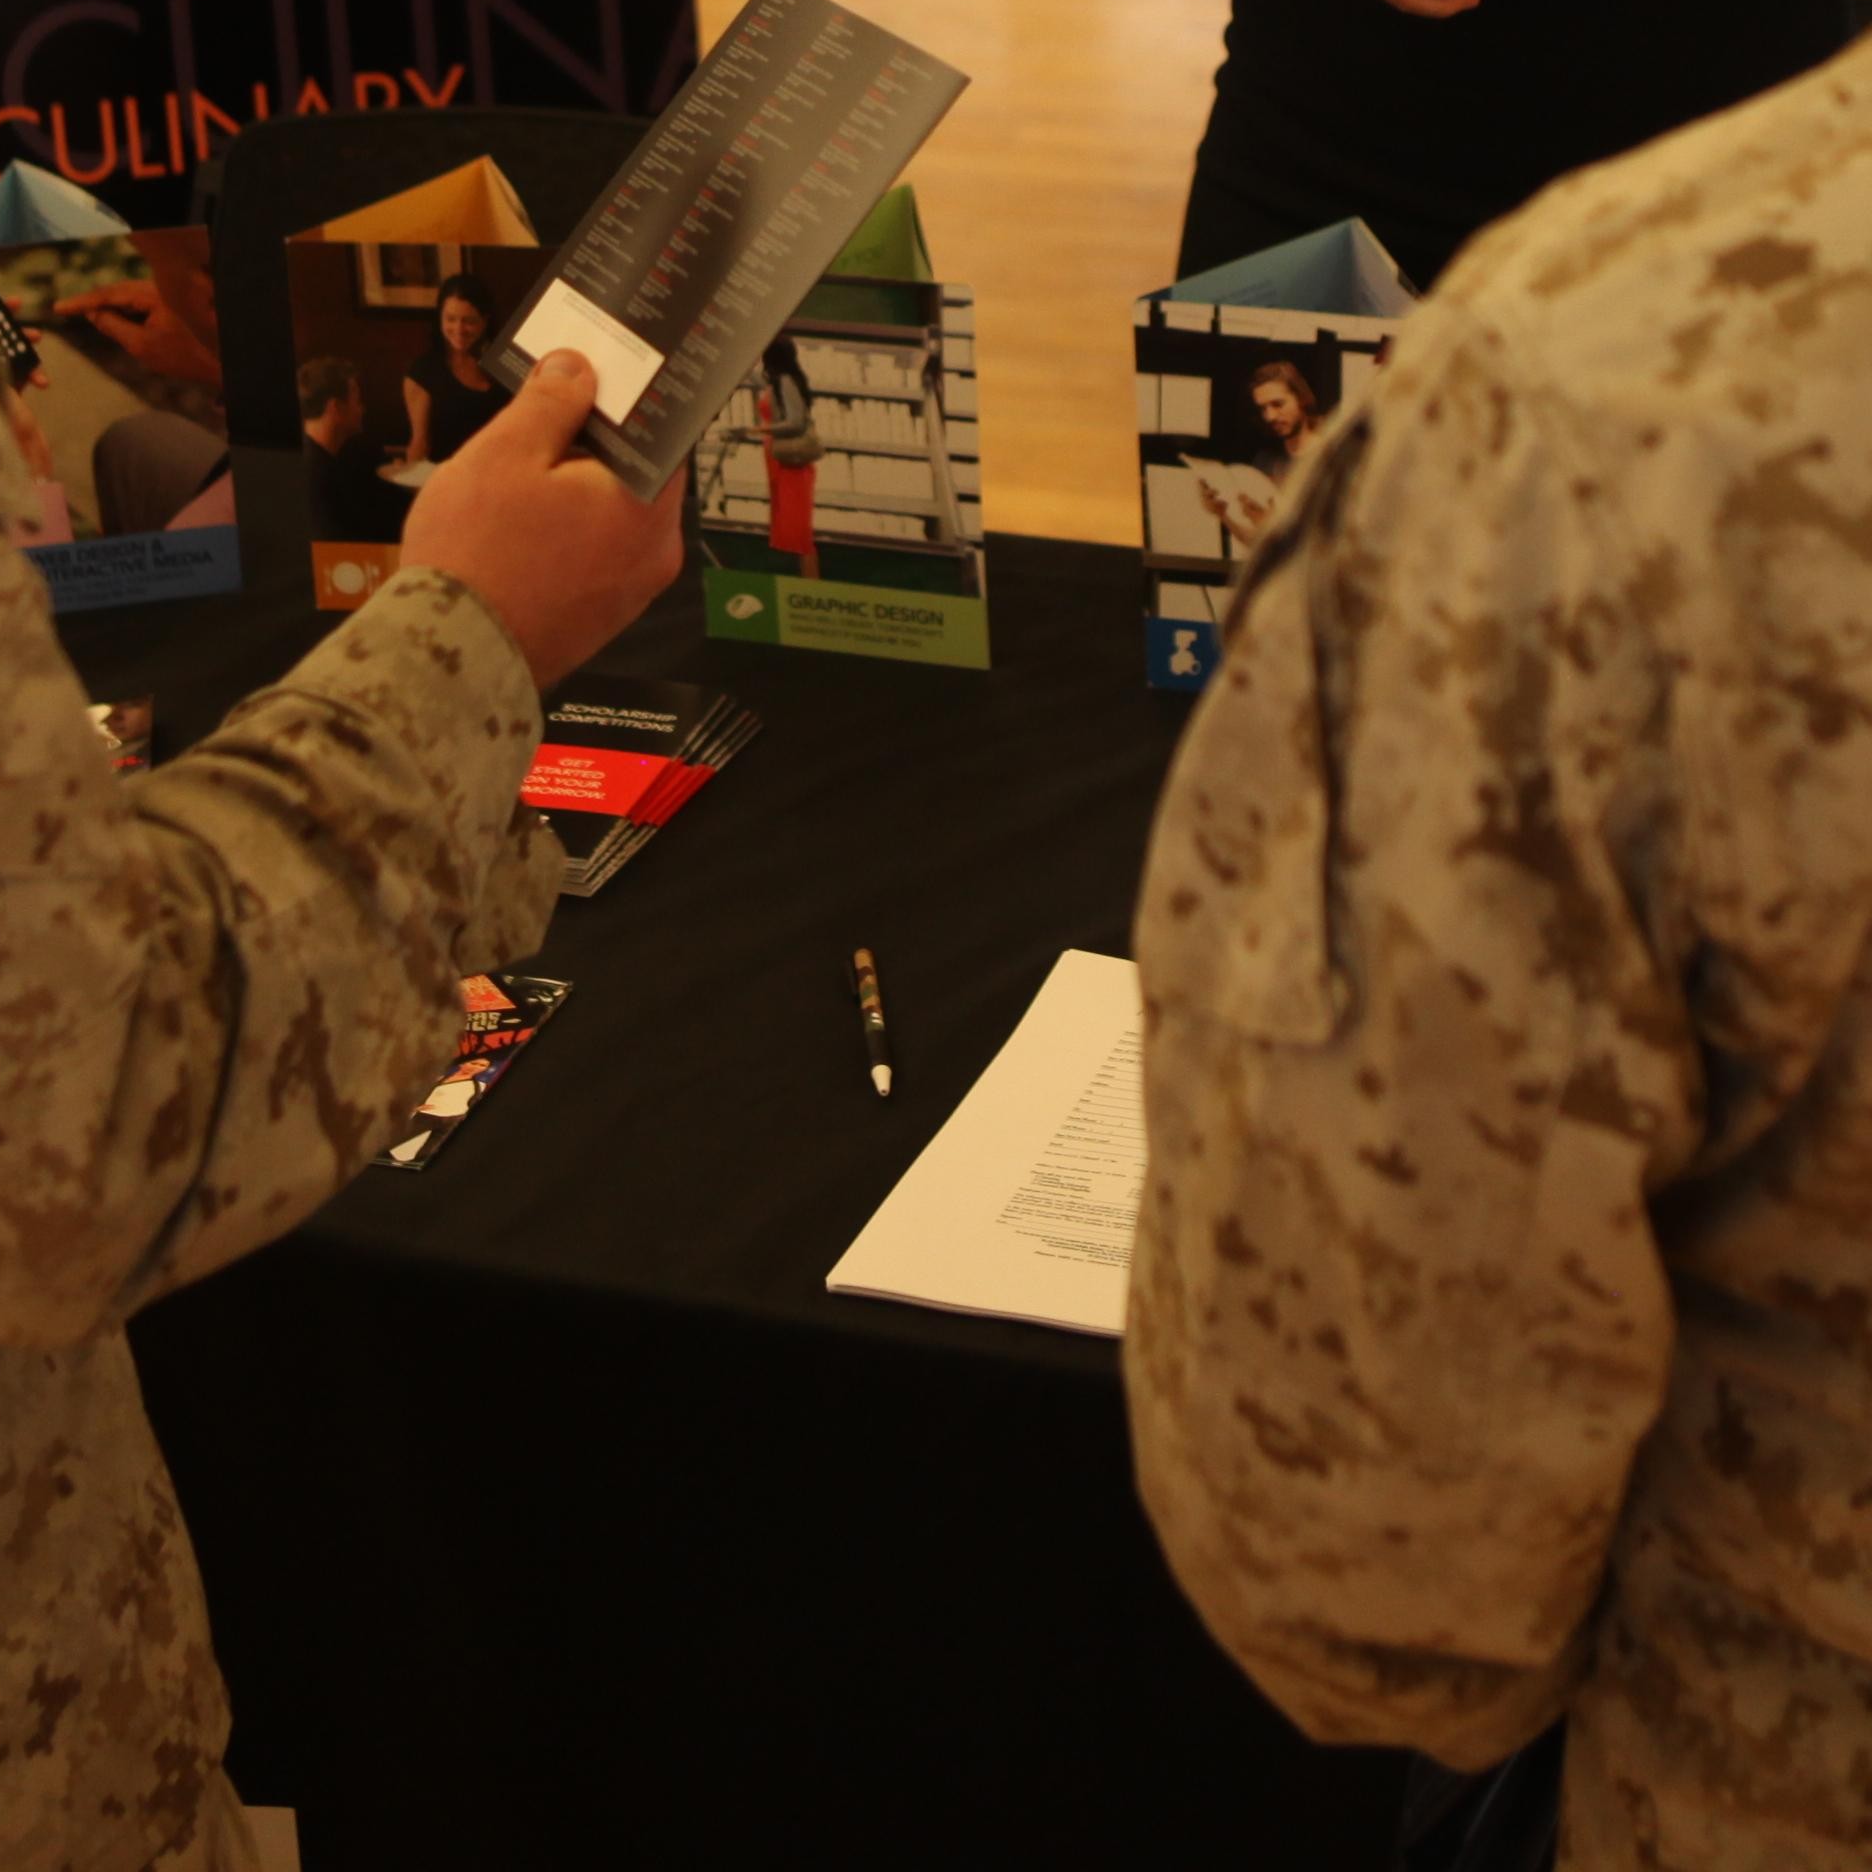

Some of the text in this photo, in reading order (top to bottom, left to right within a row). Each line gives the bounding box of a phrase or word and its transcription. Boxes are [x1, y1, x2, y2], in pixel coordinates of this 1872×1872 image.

[787, 593, 866, 618] GRAPHIC
[873, 602, 945, 627] DESIGN
[561, 702, 678, 722] SCHOLARSHIP
[548, 713, 675, 733] COMPETITIONS
